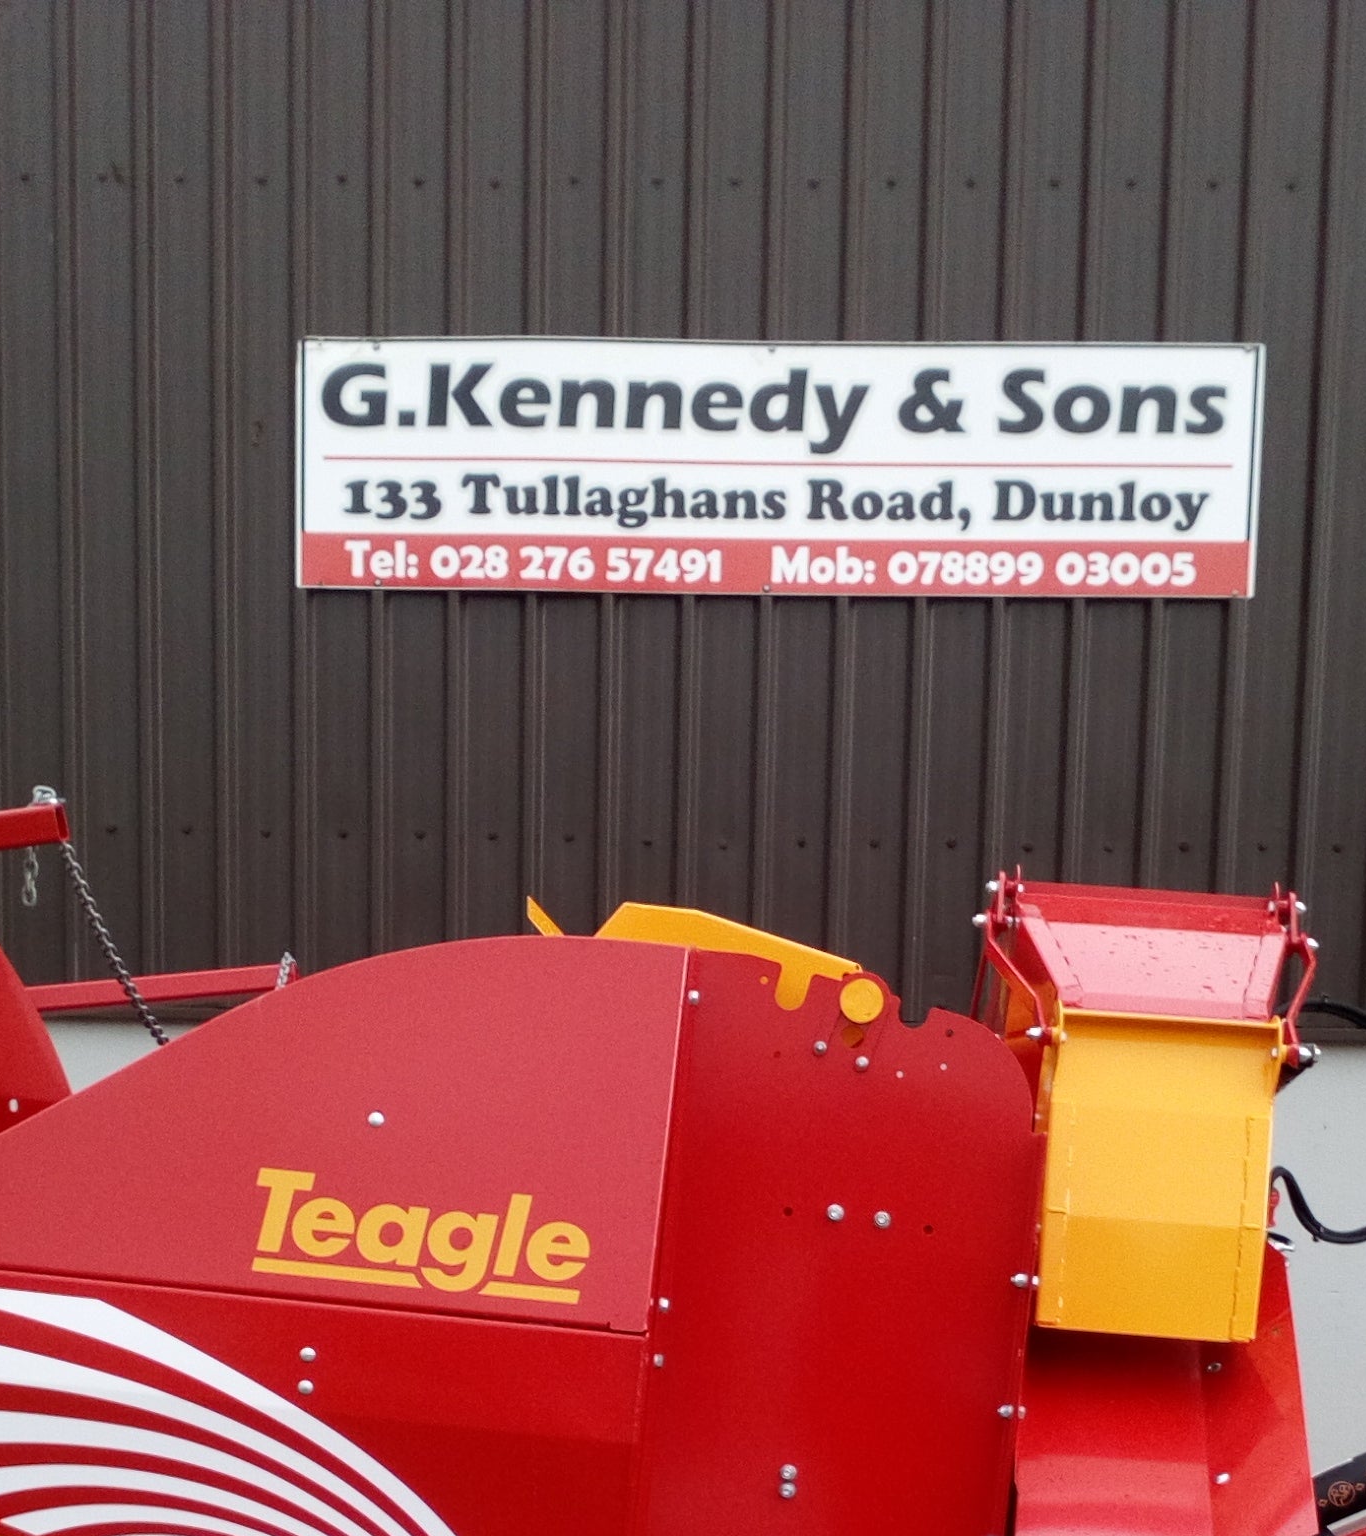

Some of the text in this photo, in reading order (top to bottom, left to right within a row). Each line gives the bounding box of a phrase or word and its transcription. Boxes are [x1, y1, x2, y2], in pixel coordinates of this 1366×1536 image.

[320, 362, 1228, 456] G.Kennedy & Sons
[343, 473, 1211, 533] 133 Tullaghans Road, Dunloy
[343, 539, 1198, 588] Tel: 028 276 57491 Mob: 078899 03005
[255, 1166, 592, 1295] Teagle
